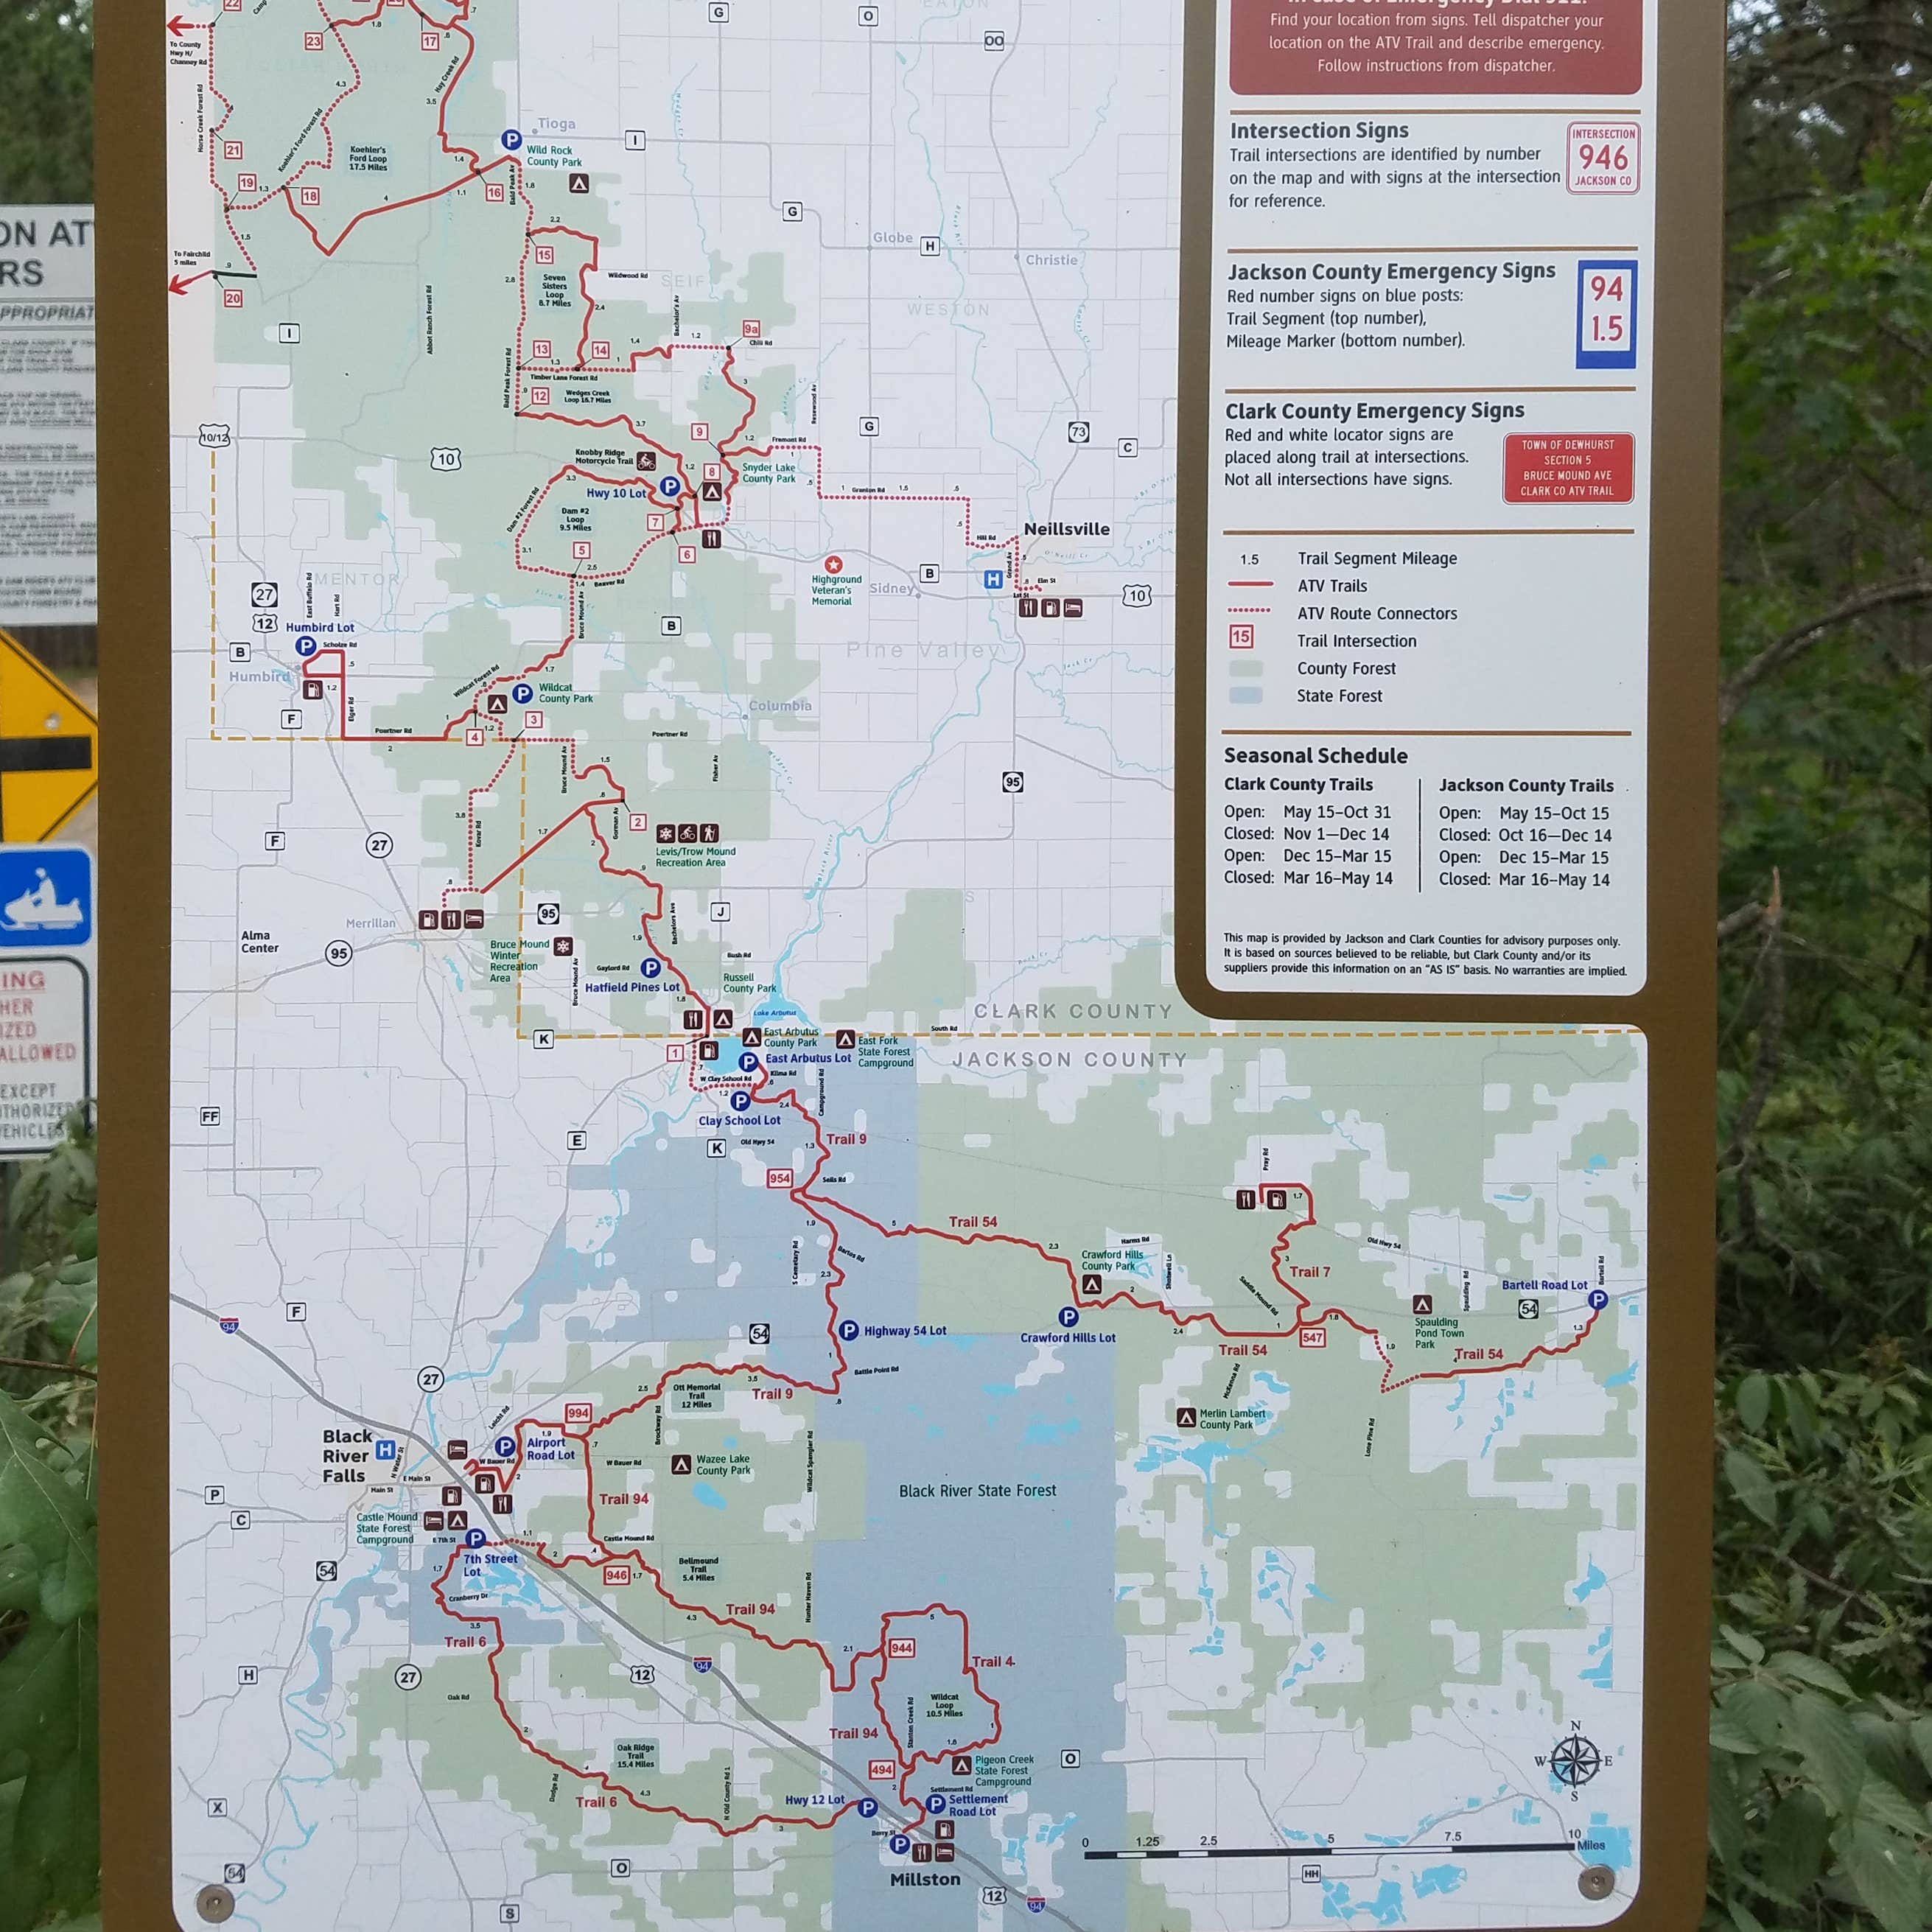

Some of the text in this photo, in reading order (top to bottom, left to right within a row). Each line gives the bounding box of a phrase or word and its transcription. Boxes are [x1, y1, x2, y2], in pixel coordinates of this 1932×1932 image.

[1271, 13, 1603, 29] Find your location from signs. Tell dispatcher your
[538, 118, 575, 130] Tioga
[1232, 122, 1408, 143] Intersection Signs
[1572, 129, 1636, 139] INTERSECTION
[527, 145, 572, 155] Wild Rock
[368, 155, 387, 164] Loop
[528, 157, 582, 168] County Park
[1580, 144, 1628, 170] 946
[1575, 176, 1631, 185] JACKSON CO
[304, 191, 317, 201] 18
[788, 206, 797, 217] G
[49, 220, 94, 246] AT
[873, 231, 914, 244] Globe
[925, 241, 935, 251] H
[1026, 254, 1077, 265] Christie
[1228, 262, 1555, 284] Jackson County Emergency Signs
[1592, 276, 1623, 301] 94
[1593, 315, 1622, 341] 1.5
[1073, 427, 1085, 436] 73
[1522, 438, 1614, 449] TOWN OF DEWHURST
[1544, 455, 1591, 465] SECTION 5
[743, 463, 795, 474] Snyder Lake
[587, 489, 647, 500] Hwy 10 Lot
[1025, 522, 1110, 535] Neillsville
[1241, 554, 1259, 564] 1.5
[1298, 551, 1457, 568] Trail Segment Mileage
[812, 575, 862, 586] Highground
[256, 589, 273, 600] 27
[812, 586, 852, 595] Veteran's
[869, 583, 915, 595] Sidney
[813, 597, 852, 605] Memorial
[1131, 590, 1145, 601] 10
[257, 619, 273, 629] 12
[287, 623, 354, 632] Humbird Lot
[1233, 631, 1249, 642] 15
[1298, 662, 1396, 678] County Forest
[749, 701, 812, 712] Columbia
[1225, 747, 1407, 763] Seasonal Schedule
[1007, 777, 1020, 788] 95
[1225, 805, 1264, 821] Open:
[1285, 805, 1312, 822] May
[1375, 805, 1391, 818] 31
[634, 818, 641, 827] 2
[657, 847, 735, 856] Levis/Trow Mound
[657, 858, 727, 867] Recreation Area
[242, 931, 270, 939] Alma
[1224, 933, 1620, 948] This map is provided by Jackson and Clark Counties for advisory purposes only.
[242, 944, 279, 953] Center
[586, 982, 679, 992] Hatfield Pines Lot
[974, 1004, 1172, 1019] CLARK COUNTY
[0, 1044, 76, 1061] ALLOWED
[953, 1051, 1187, 1068] JACKSON COUNTY
[1, 1083, 56, 1099] EXCEPT
[827, 1132, 867, 1145] Trail 9
[771, 1174, 790, 1183] 954
[949, 1217, 997, 1227] Trail 54
[1379, 1240, 1392, 1248] Hwy
[1502, 1280, 1587, 1289] Bartell Road Lot
[1522, 1303, 1536, 1315] 54
[865, 1326, 946, 1338] Highway 54 Lot
[1303, 1333, 1323, 1343] 547
[568, 1408, 589, 1418] 994
[324, 1429, 372, 1443] Black
[323, 1449, 369, 1463] River
[323, 1469, 365, 1483] Falls
[900, 1484, 1056, 1497] Black River State Forest
[600, 1494, 650, 1504] Trail 94
[607, 1570, 627, 1581] 946
[892, 1643, 912, 1653] 944
[872, 1765, 892, 1774] 494
[949, 1794, 1009, 1804] Settlement
[214, 1802, 222, 1813] X
[950, 1807, 996, 1816] Road Lot
[1136, 1837, 1159, 1847] 1.25
[1445, 1832, 1461, 1841] 7.5
[1578, 1840, 1606, 1851] Miles
[892, 1873, 960, 1886] Millston
[1304, 1869, 1318, 1879] HH
